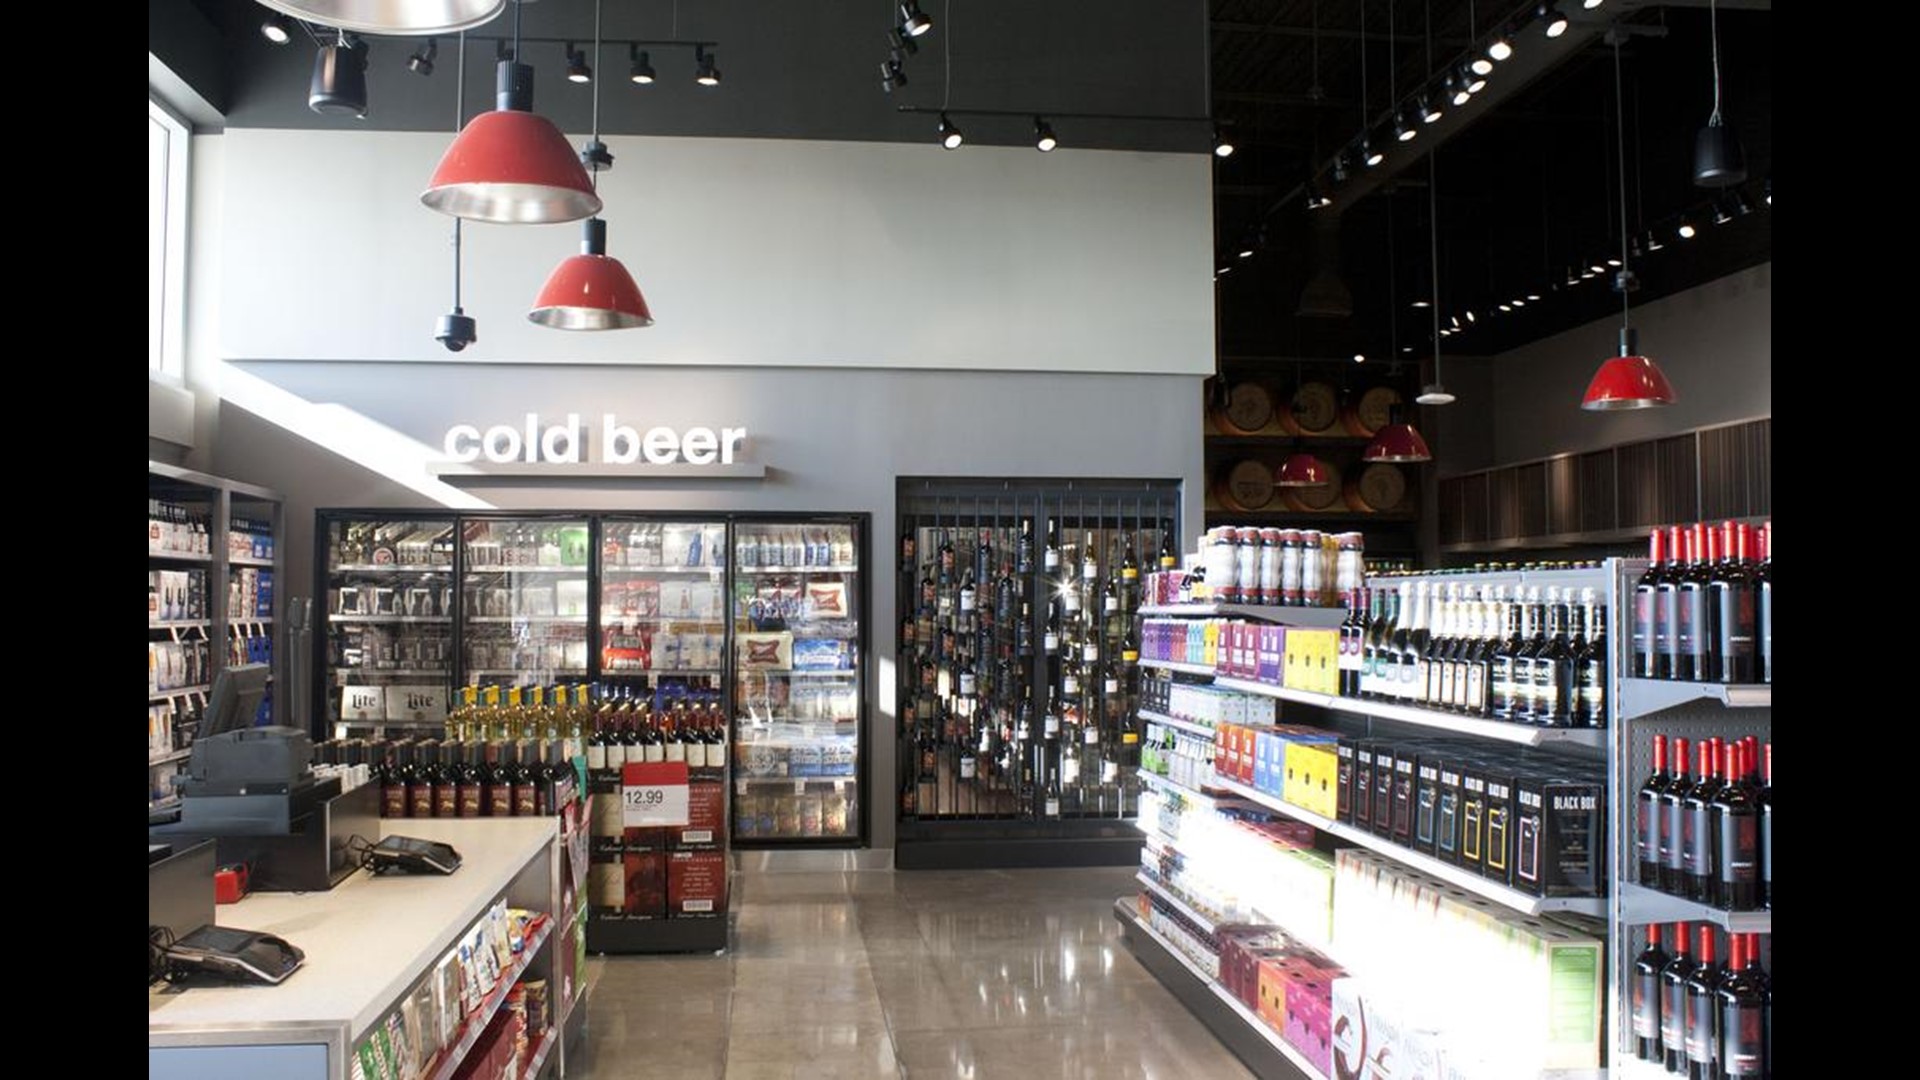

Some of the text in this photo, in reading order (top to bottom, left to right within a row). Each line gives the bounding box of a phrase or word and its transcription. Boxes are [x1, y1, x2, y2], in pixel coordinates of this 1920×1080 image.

[444, 413, 746, 464] cold beer
[352, 694, 376, 709] Lite
[407, 693, 434, 710] Lite
[625, 790, 664, 804] 12.99
[1554, 796, 1597, 810] BLACK BOX
